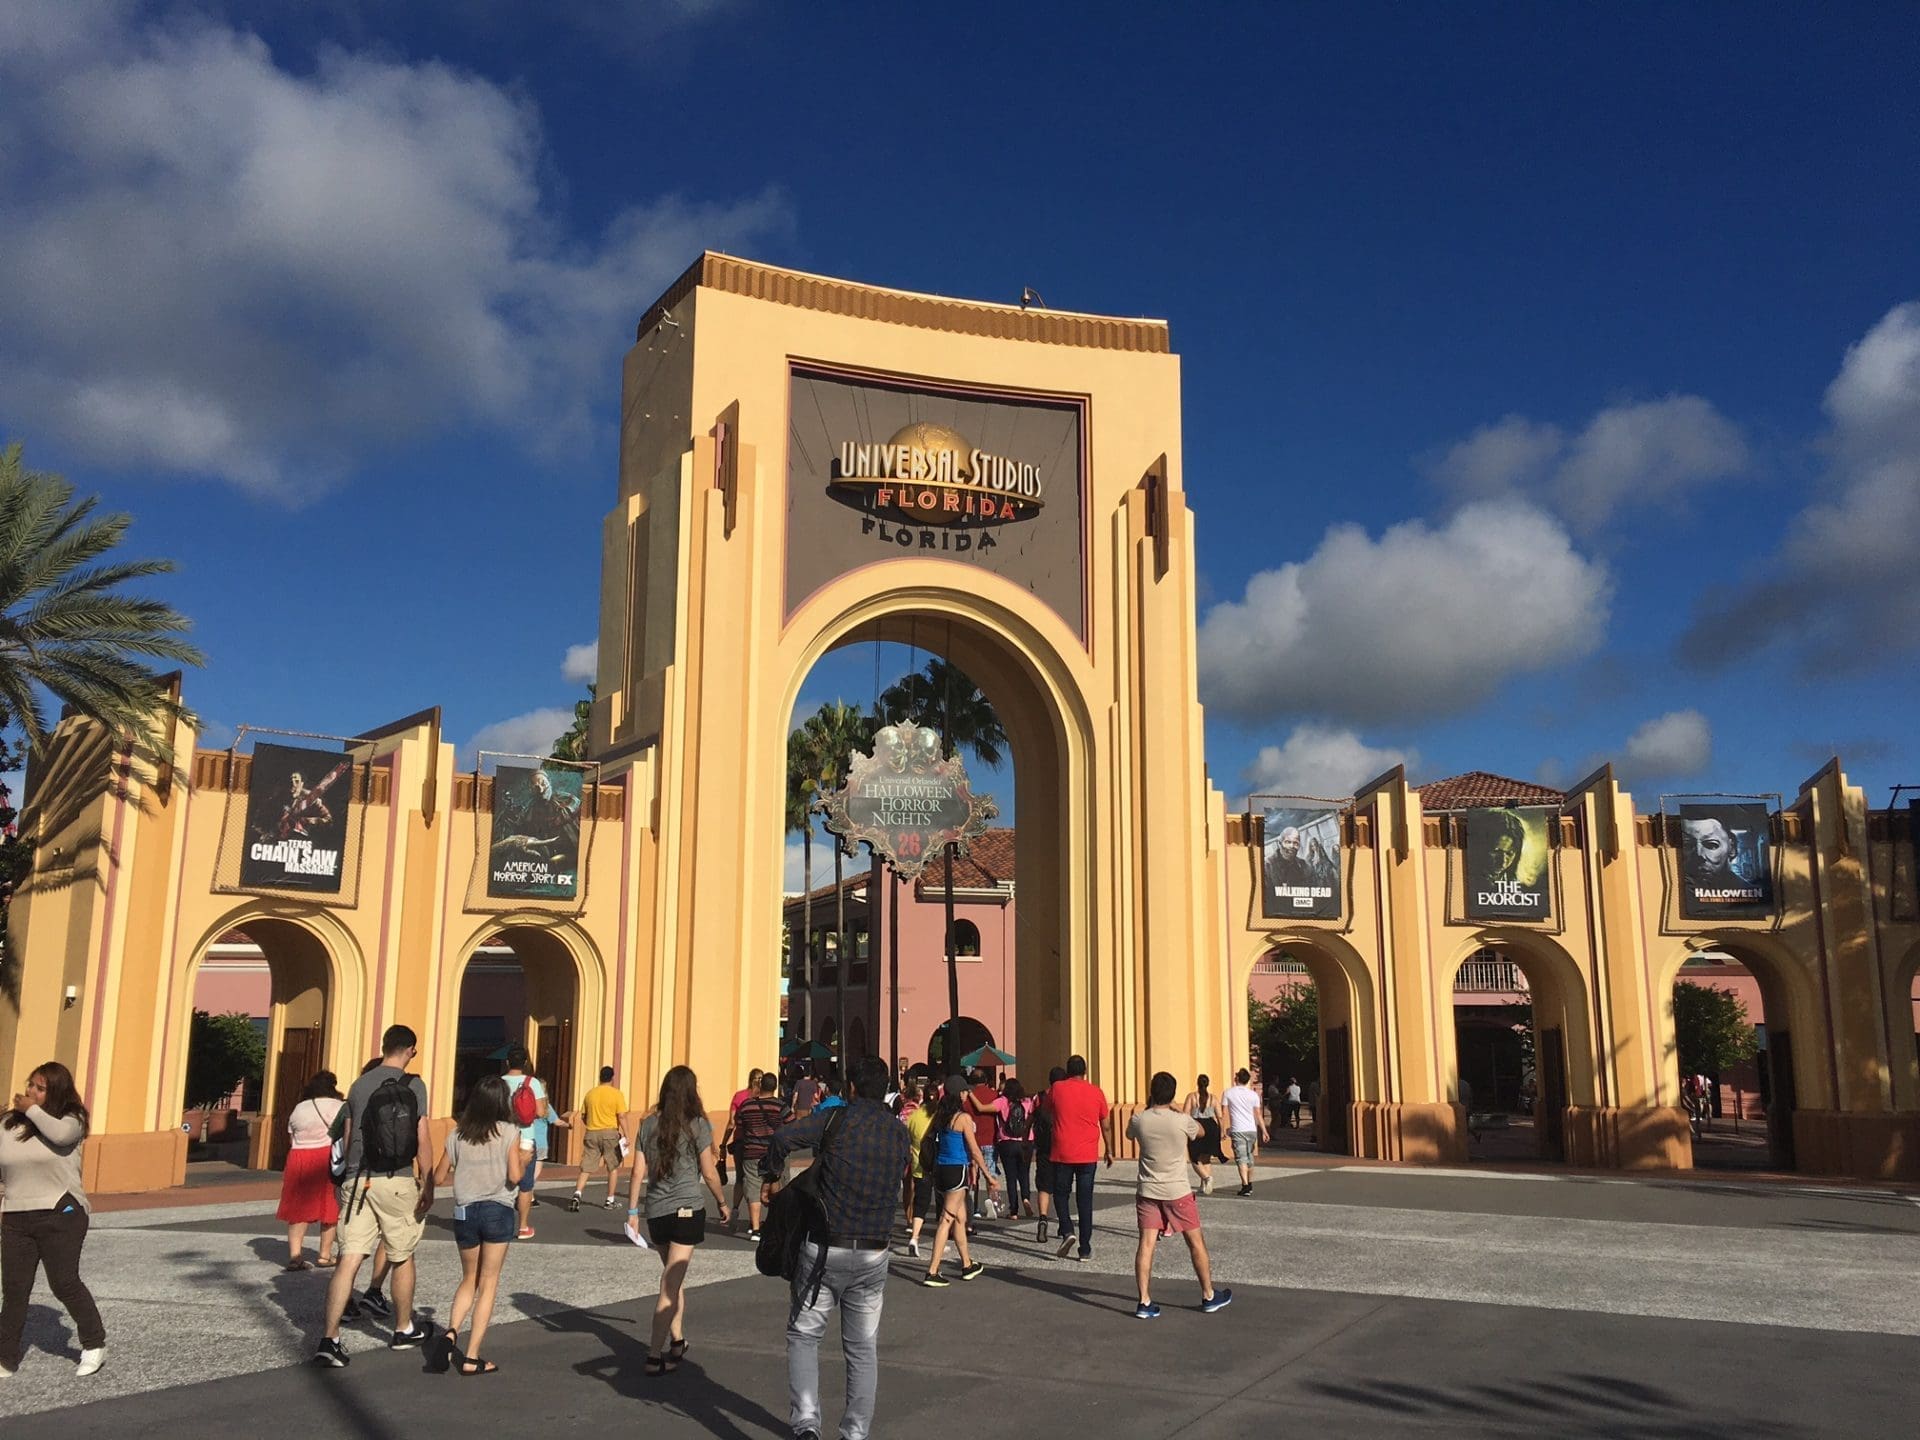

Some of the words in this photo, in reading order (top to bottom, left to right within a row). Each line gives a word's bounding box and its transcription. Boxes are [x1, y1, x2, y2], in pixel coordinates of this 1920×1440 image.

[841, 441, 965, 483] UNIVERSAL
[968, 448, 1042, 497] STUDIOS
[878, 489, 1015, 519] FLORIDA
[865, 784, 952, 798] HALLOWEEN
[880, 797, 942, 813] HORROR
[872, 811, 932, 826] NIGHTS
[288, 839, 313, 850] TEXAS
[251, 843, 299, 864] CHAIN
[301, 847, 338, 868] SAW
[284, 863, 335, 876] MASSACRE
[503, 861, 549, 873] AMERICAN
[493, 871, 528, 883] HORROR
[530, 873, 556, 884] STORY
[557, 874, 573, 885] FX
[1275, 886, 1310, 897] WALKING
[1311, 887, 1332, 898] DEAD
[1494, 880, 1522, 893] THE
[1695, 888, 1763, 897] HALLOWEEN
[1478, 892, 1541, 906] EXORCIST
